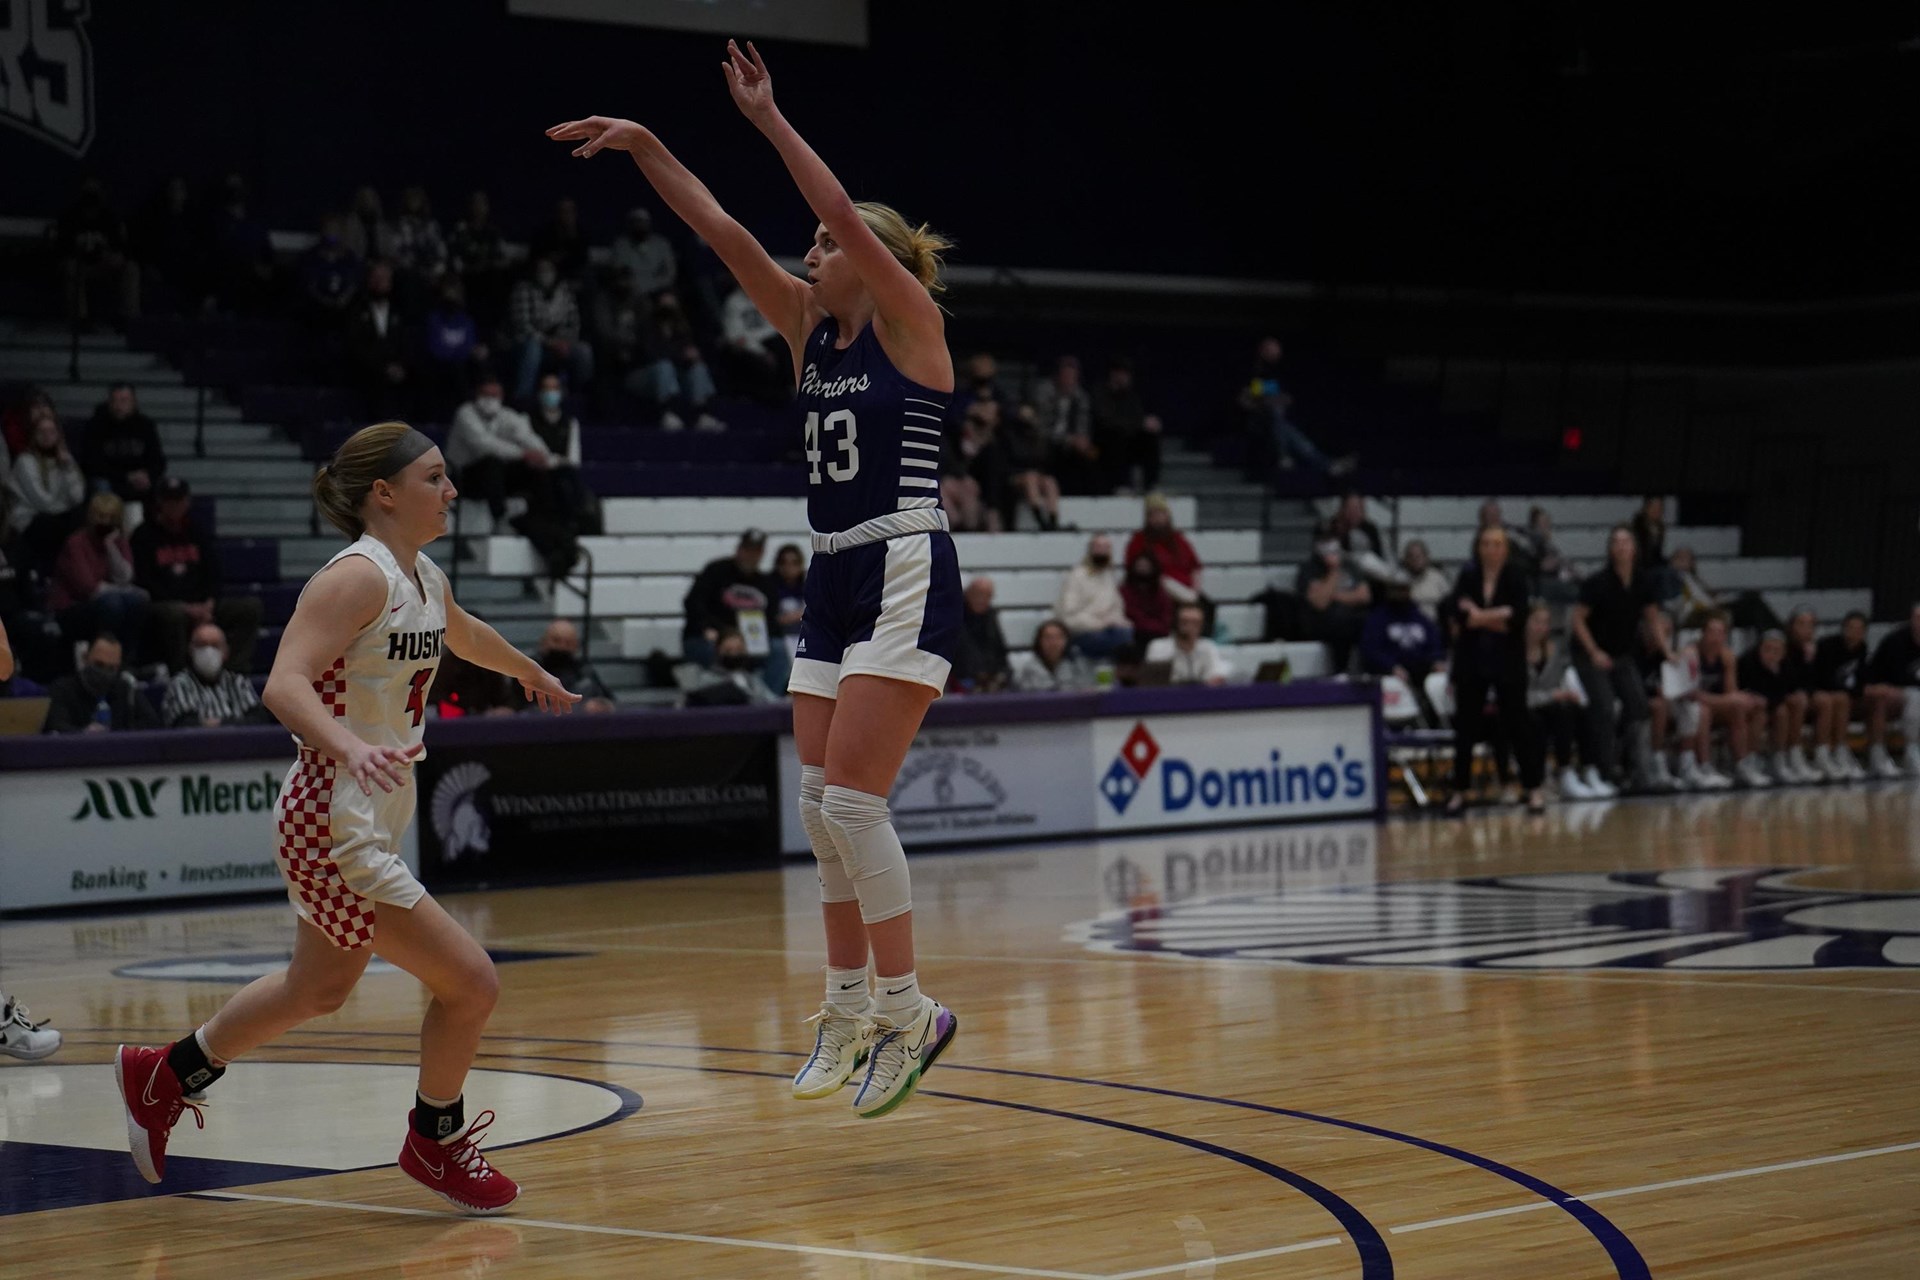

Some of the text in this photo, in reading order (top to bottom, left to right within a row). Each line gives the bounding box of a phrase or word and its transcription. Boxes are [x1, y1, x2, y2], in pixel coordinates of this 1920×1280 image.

[805, 408, 860, 485] 43
[1161, 745, 1366, 811] Domino's
[71, 865, 149, 891] Banking
